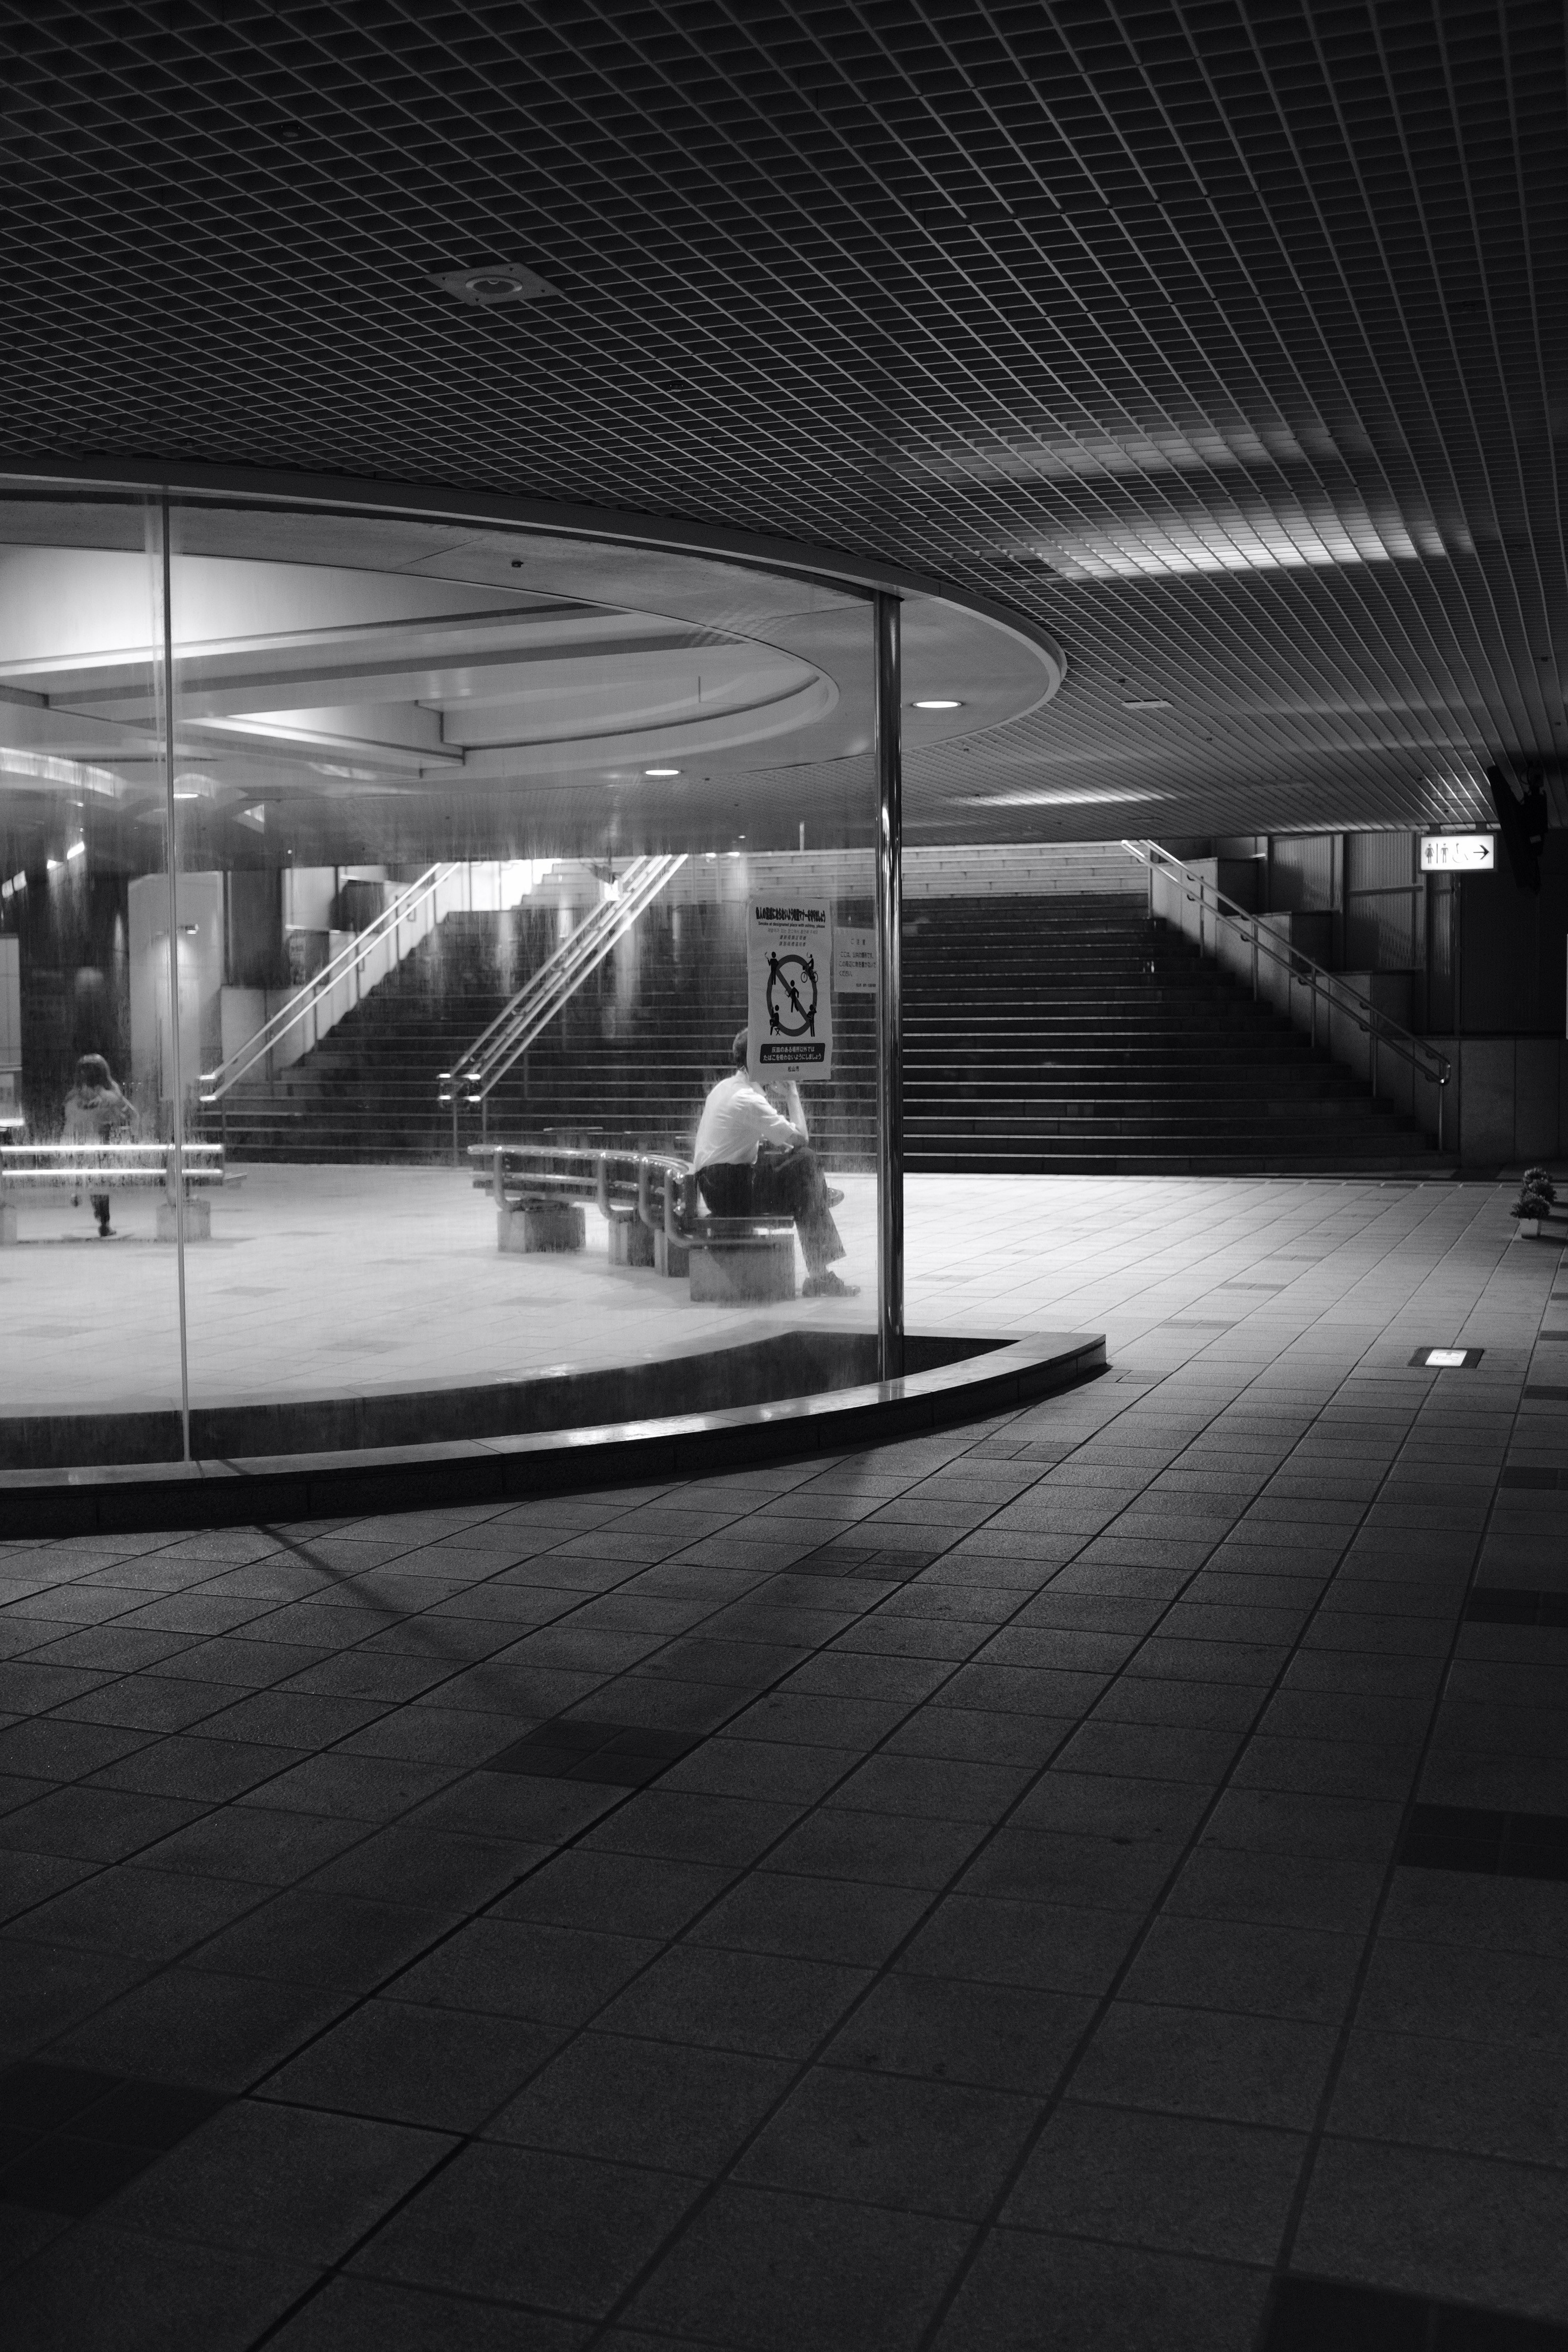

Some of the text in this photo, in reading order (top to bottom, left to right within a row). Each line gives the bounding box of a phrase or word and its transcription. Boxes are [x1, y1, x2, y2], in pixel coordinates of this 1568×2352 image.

[763, 1053, 822, 1061] たばこを吸わないようにしましょう
